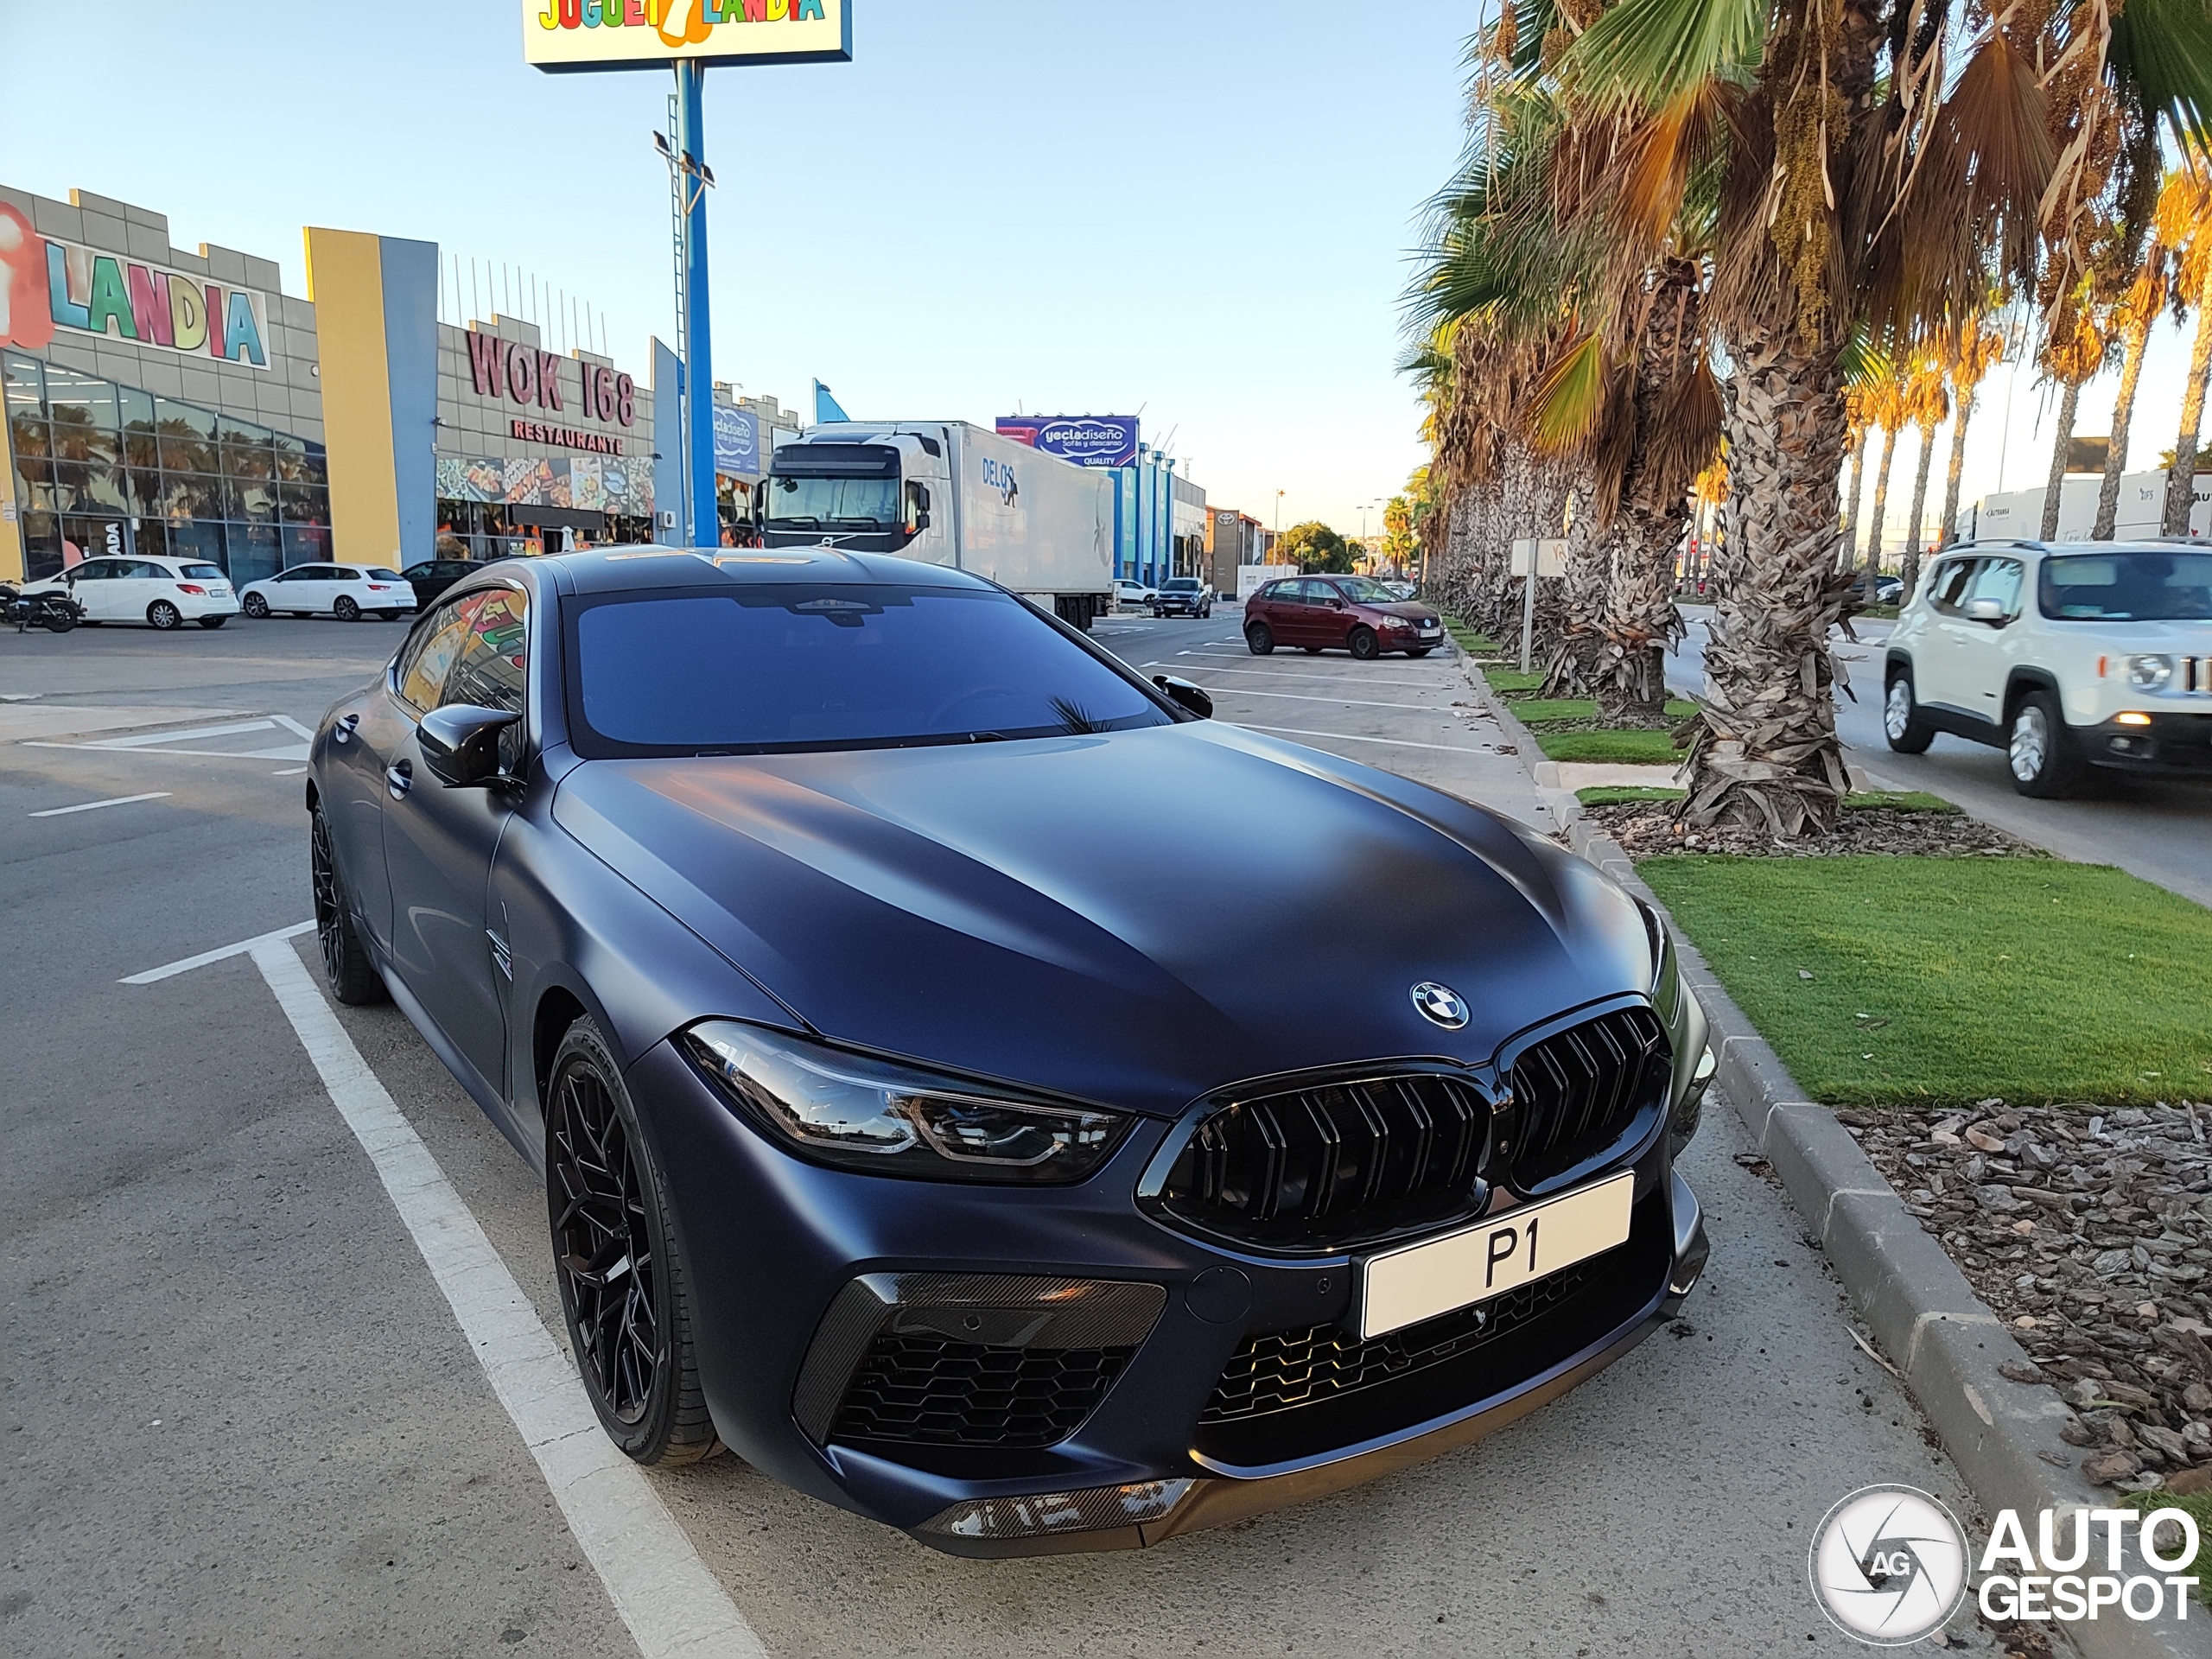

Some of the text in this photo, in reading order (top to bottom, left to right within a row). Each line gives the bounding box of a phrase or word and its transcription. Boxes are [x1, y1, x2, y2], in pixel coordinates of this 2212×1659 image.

[467, 331, 563, 411] WOK
[512, 420, 623, 455] RESTAURANTE
[1046, 429, 1122, 443] yecladiseño
[1084, 457, 1116, 466] QUALITY
[2193, 492, 2212, 502] AU
[105, 523, 122, 556] ADA
[1485, 1217, 1539, 1288] P1
